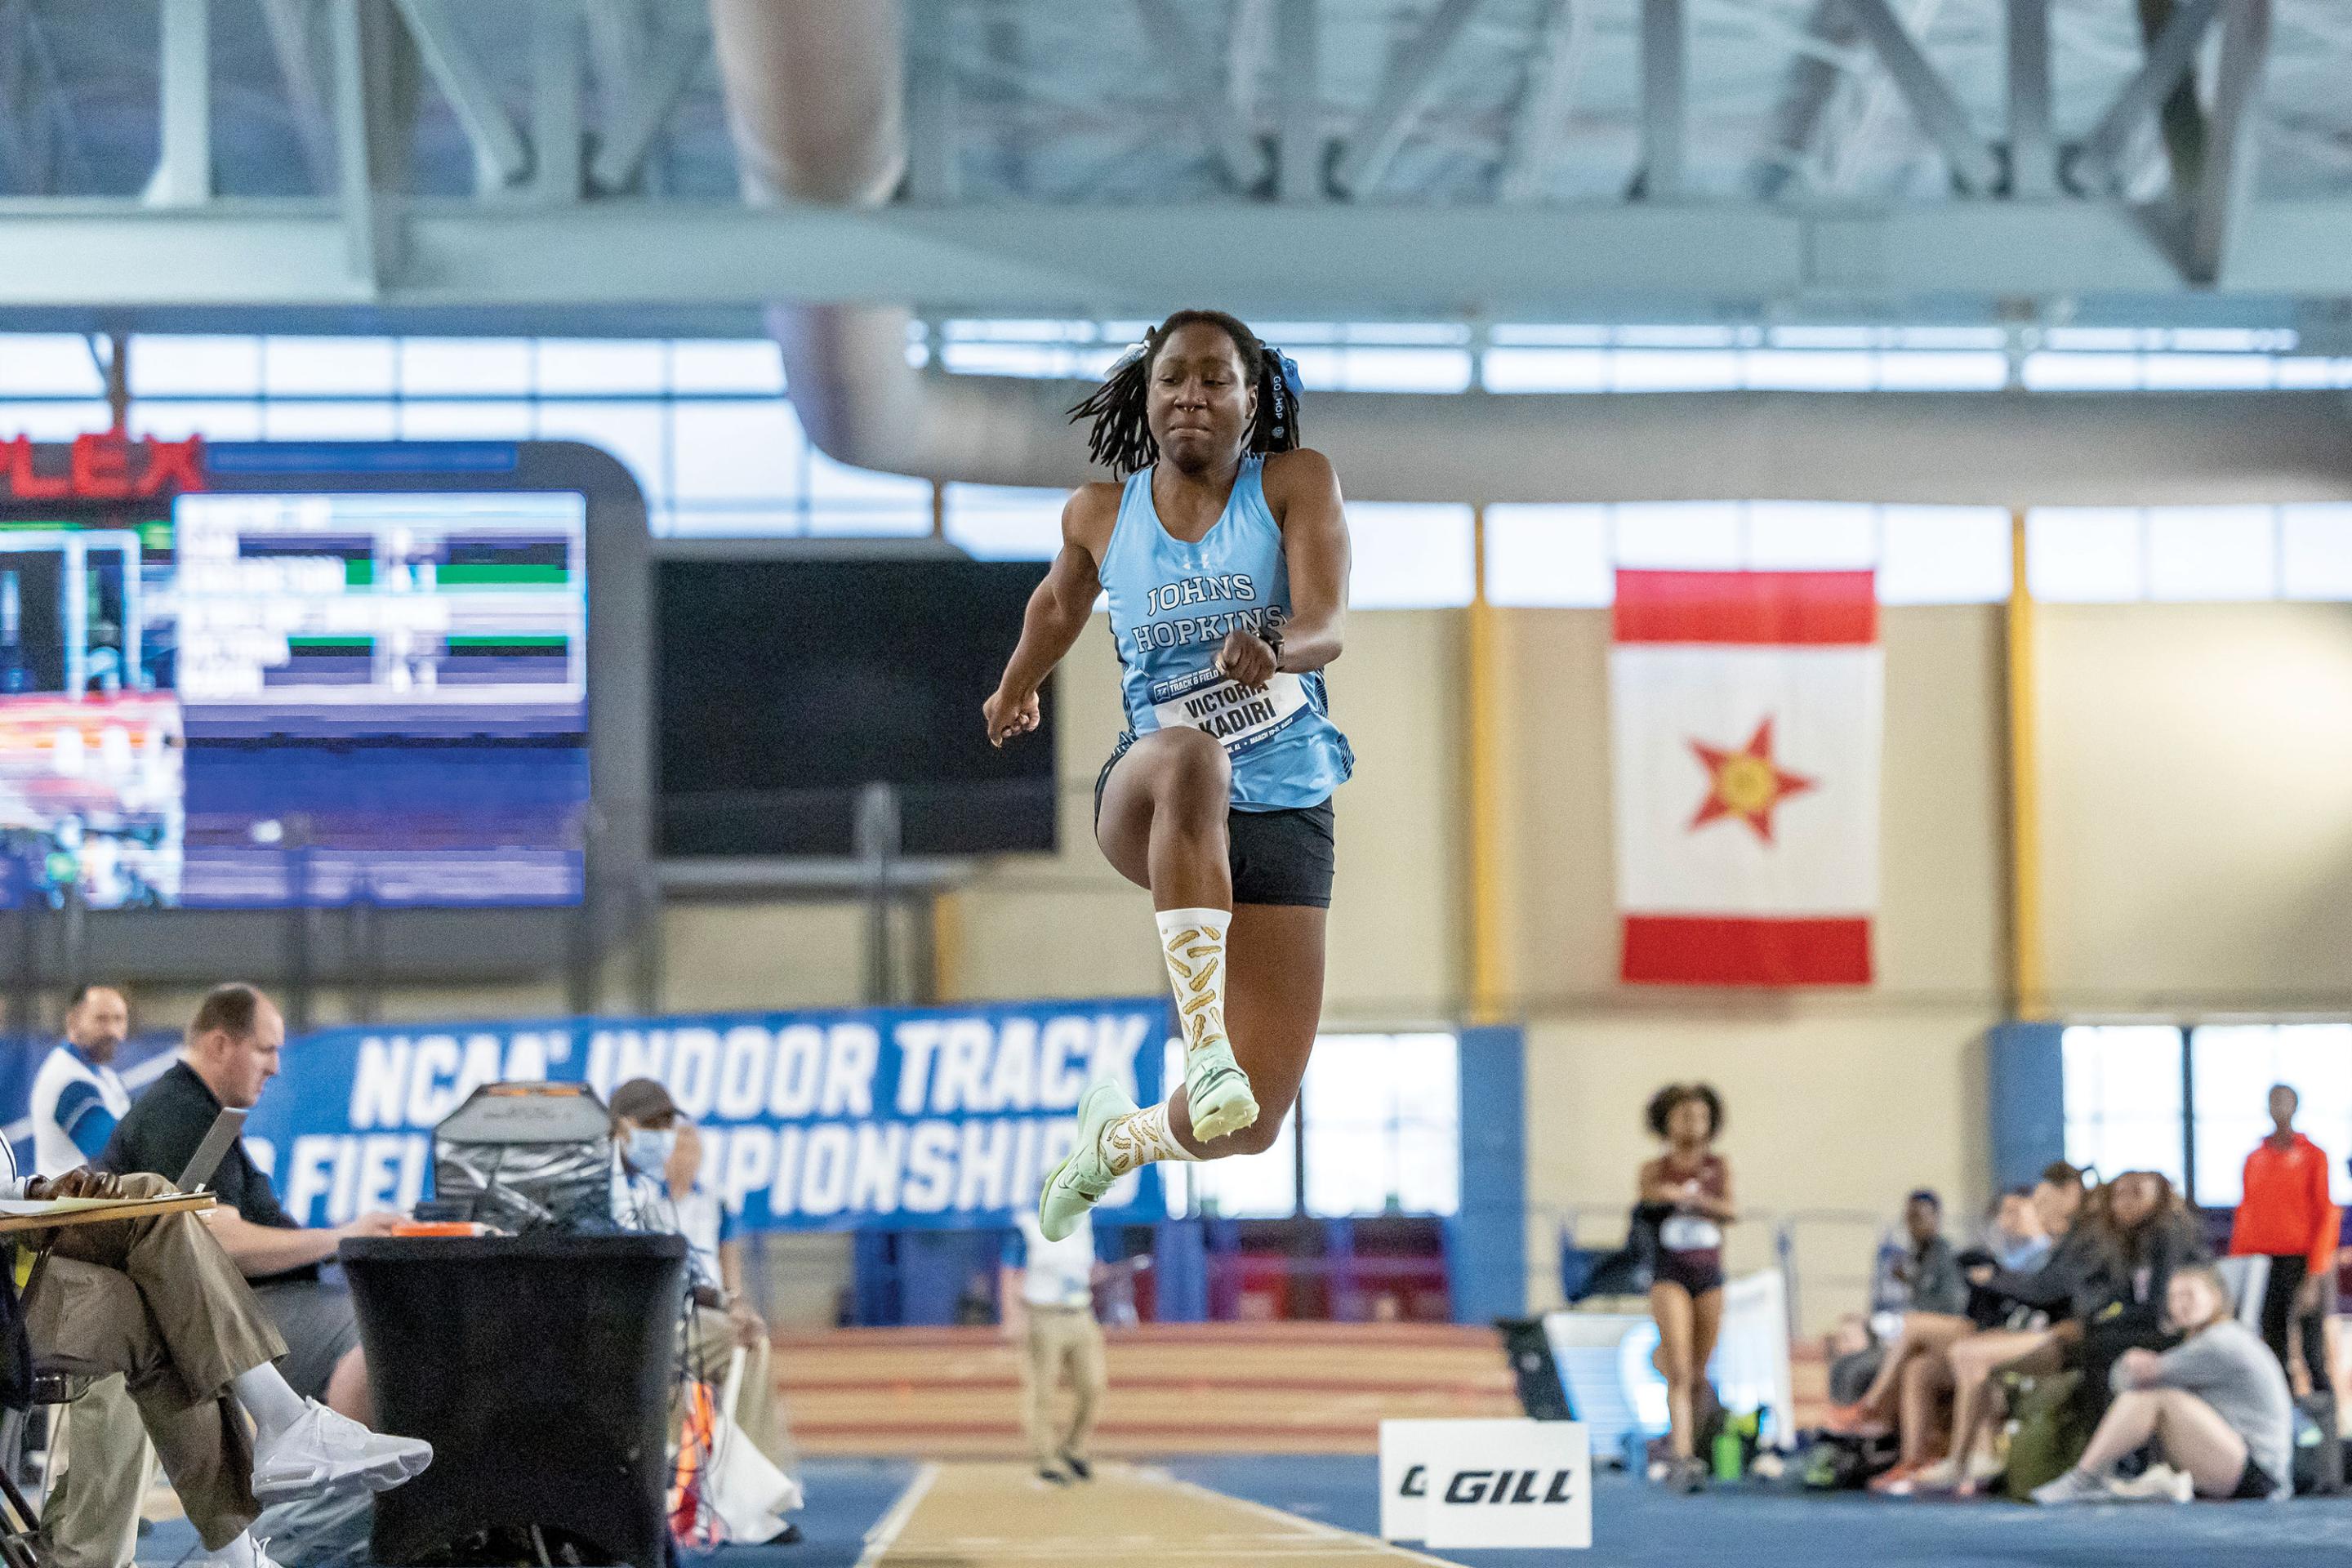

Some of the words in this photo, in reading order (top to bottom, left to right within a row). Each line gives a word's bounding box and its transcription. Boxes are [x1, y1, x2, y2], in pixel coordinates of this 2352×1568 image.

[1274, 376, 1282, 391] GO
[0, 434, 205, 498] LEX
[1147, 573, 1256, 616] JOHNS
[1132, 605, 1285, 653] HOPKINS
[1169, 679, 1193, 693] TRACK
[1193, 676, 1200, 685] &
[1199, 669, 1219, 685] FIELD
[1198, 697, 1277, 739] KADIRI
[586, 1022, 879, 1120] INDOOR
[895, 1013, 1150, 1116] TRACK
[286, 1134, 433, 1227] FIEL
[1444, 1469, 1571, 1504] GILL
